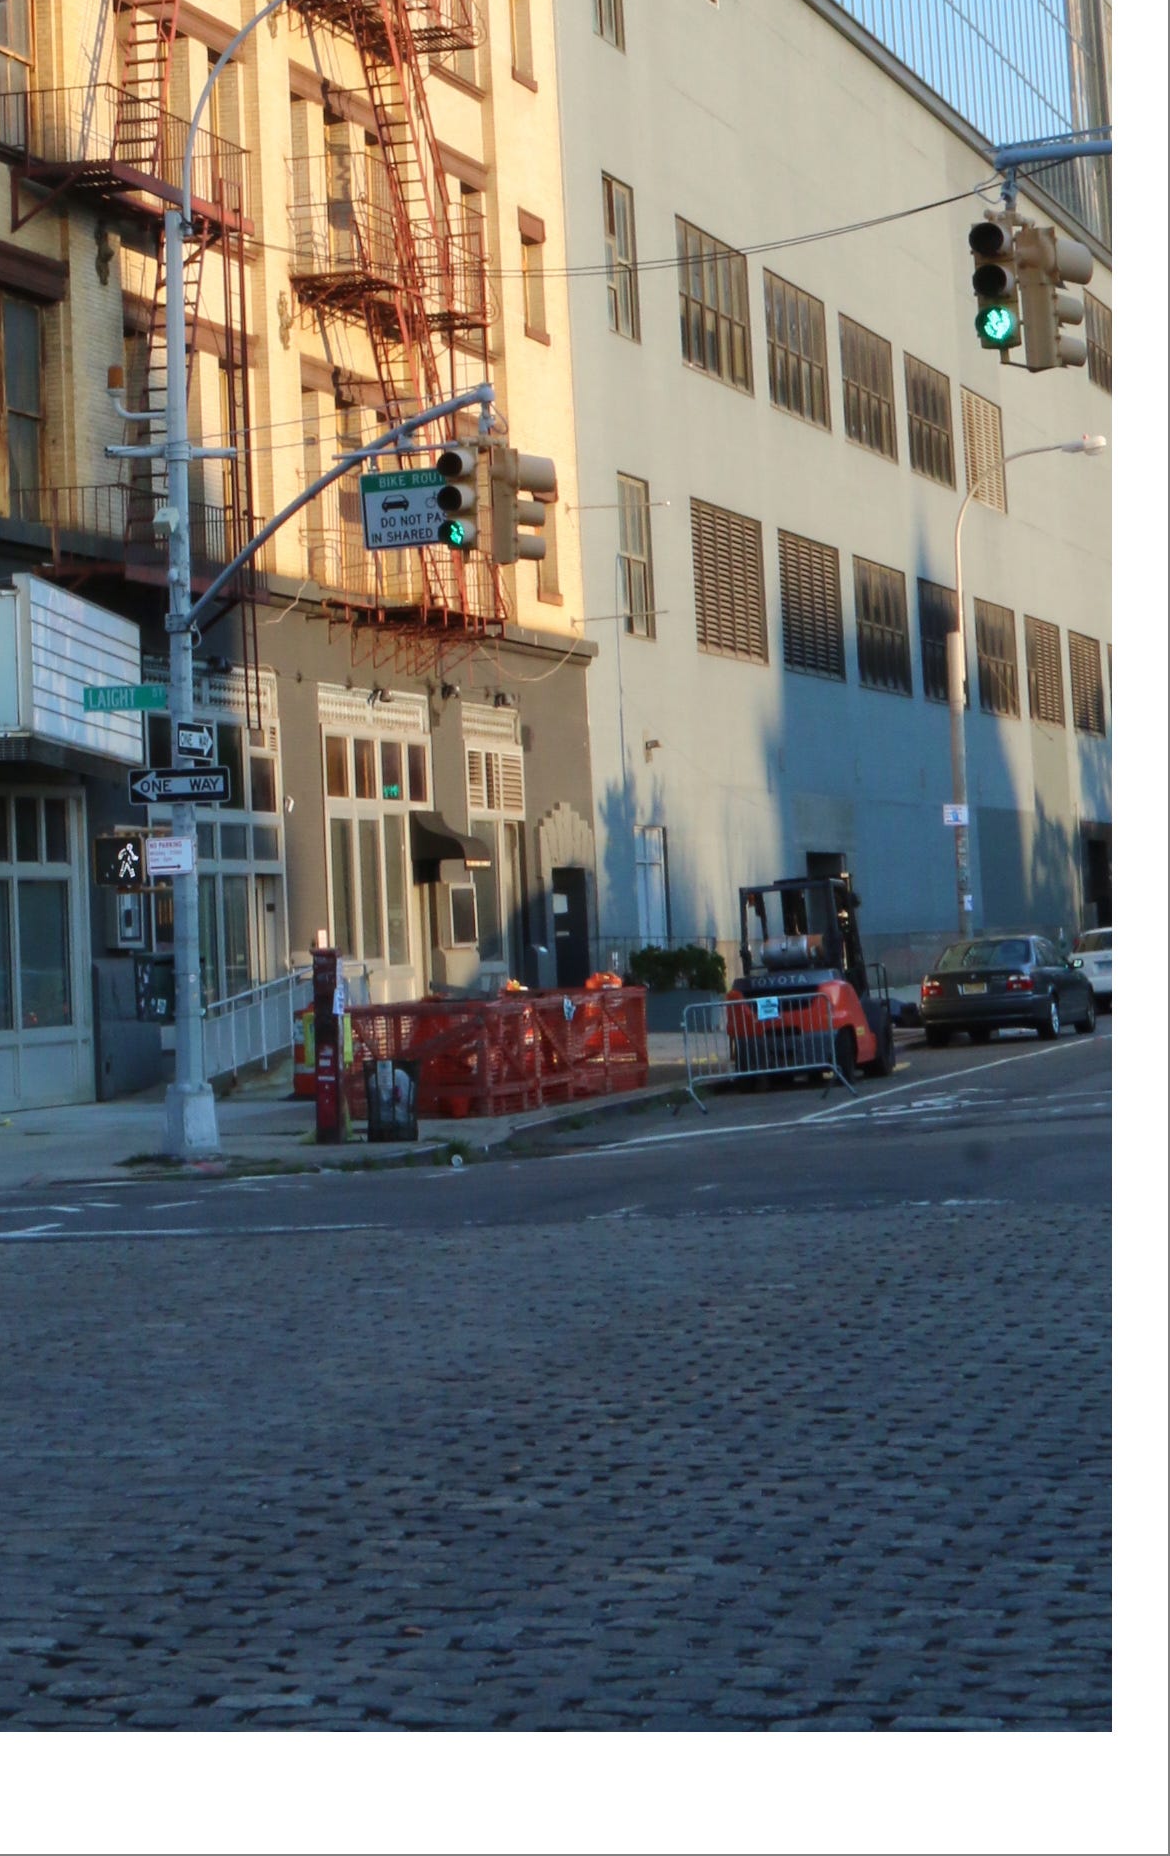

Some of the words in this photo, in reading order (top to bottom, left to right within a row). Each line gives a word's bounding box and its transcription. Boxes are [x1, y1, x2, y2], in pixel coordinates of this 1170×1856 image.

[379, 475, 406, 489] BIKE
[381, 516, 396, 529] DO
[400, 514, 422, 527] NOT
[371, 533, 382, 543] IN
[387, 528, 433, 542] SHARED
[89, 688, 136, 709] LAIGHT
[180, 732, 193, 746] ONE
[199, 734, 210, 749] WAY
[140, 779, 172, 793] ONE
[190, 777, 220, 791] WAY
[751, 974, 808, 987] TOYOTA
